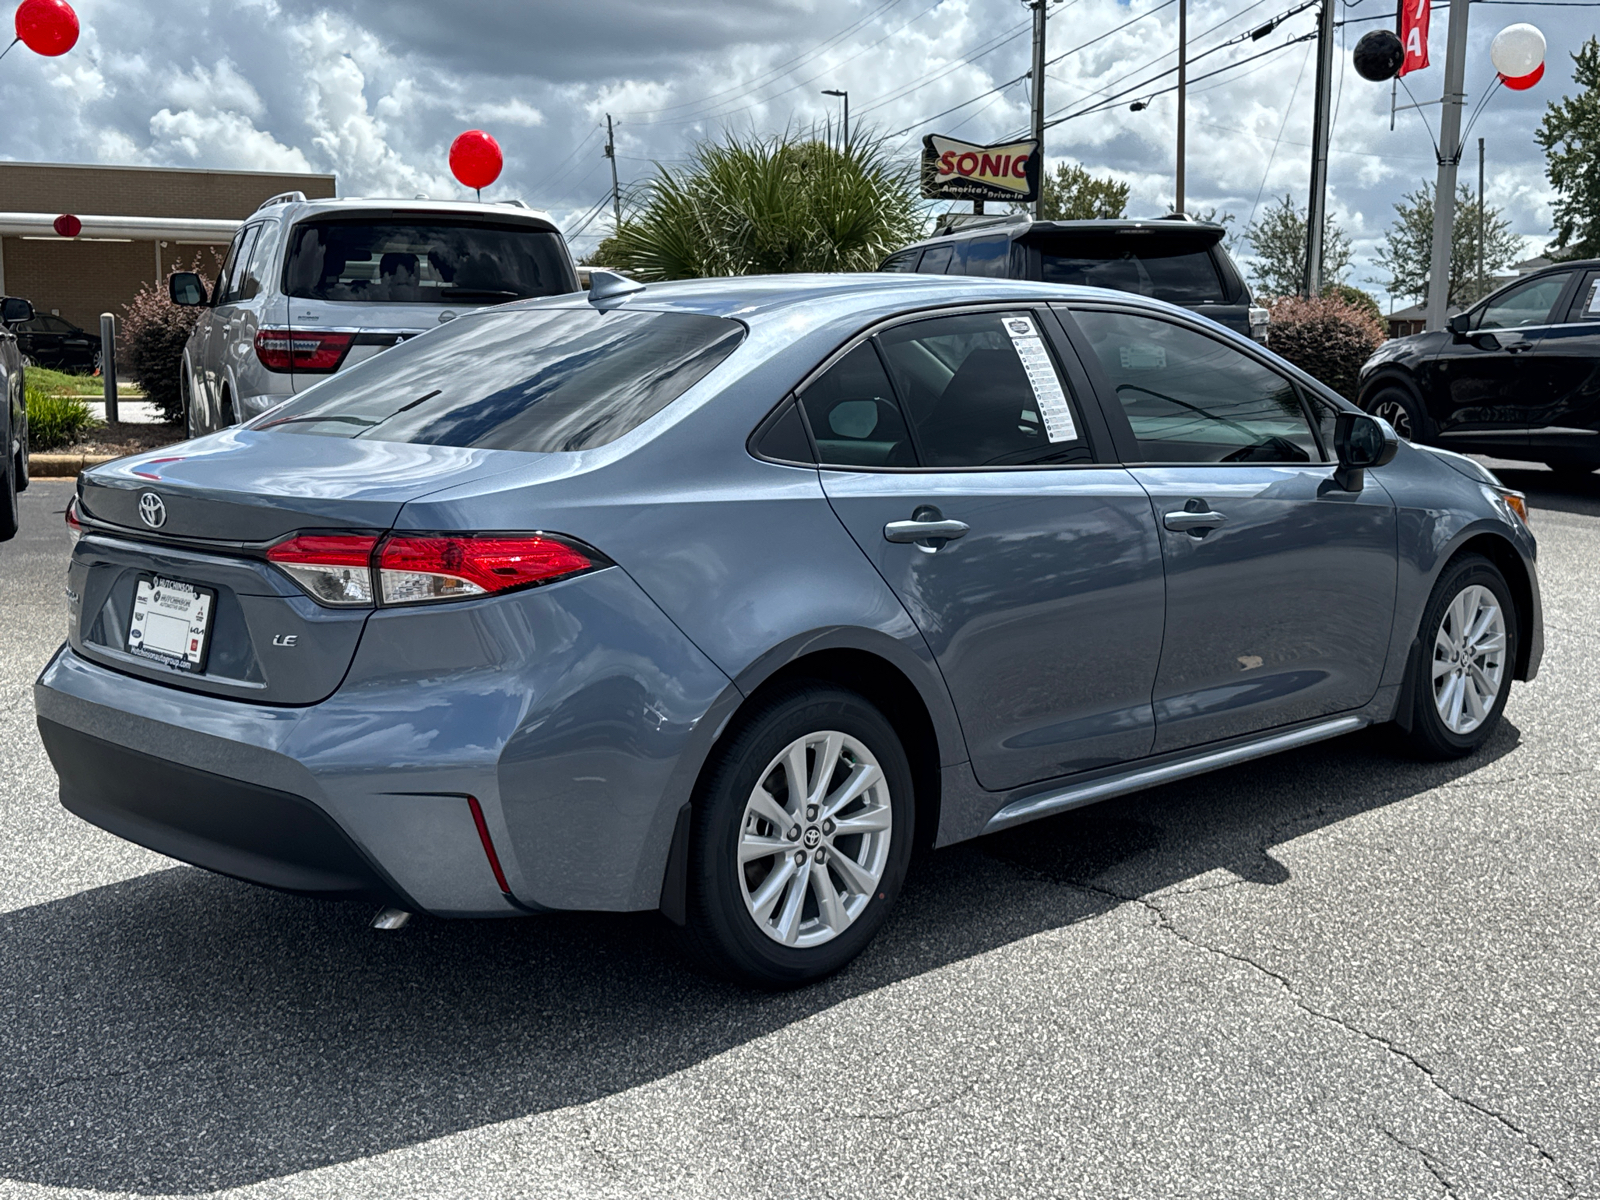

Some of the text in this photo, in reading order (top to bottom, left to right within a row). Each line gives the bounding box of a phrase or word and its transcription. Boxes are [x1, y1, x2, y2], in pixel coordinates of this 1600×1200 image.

[938, 150, 1029, 178] SONIC
[941, 184, 1024, 200] America's Drive-In
[159, 578, 194, 593] HUTCHINSON
[273, 635, 298, 647] LE
